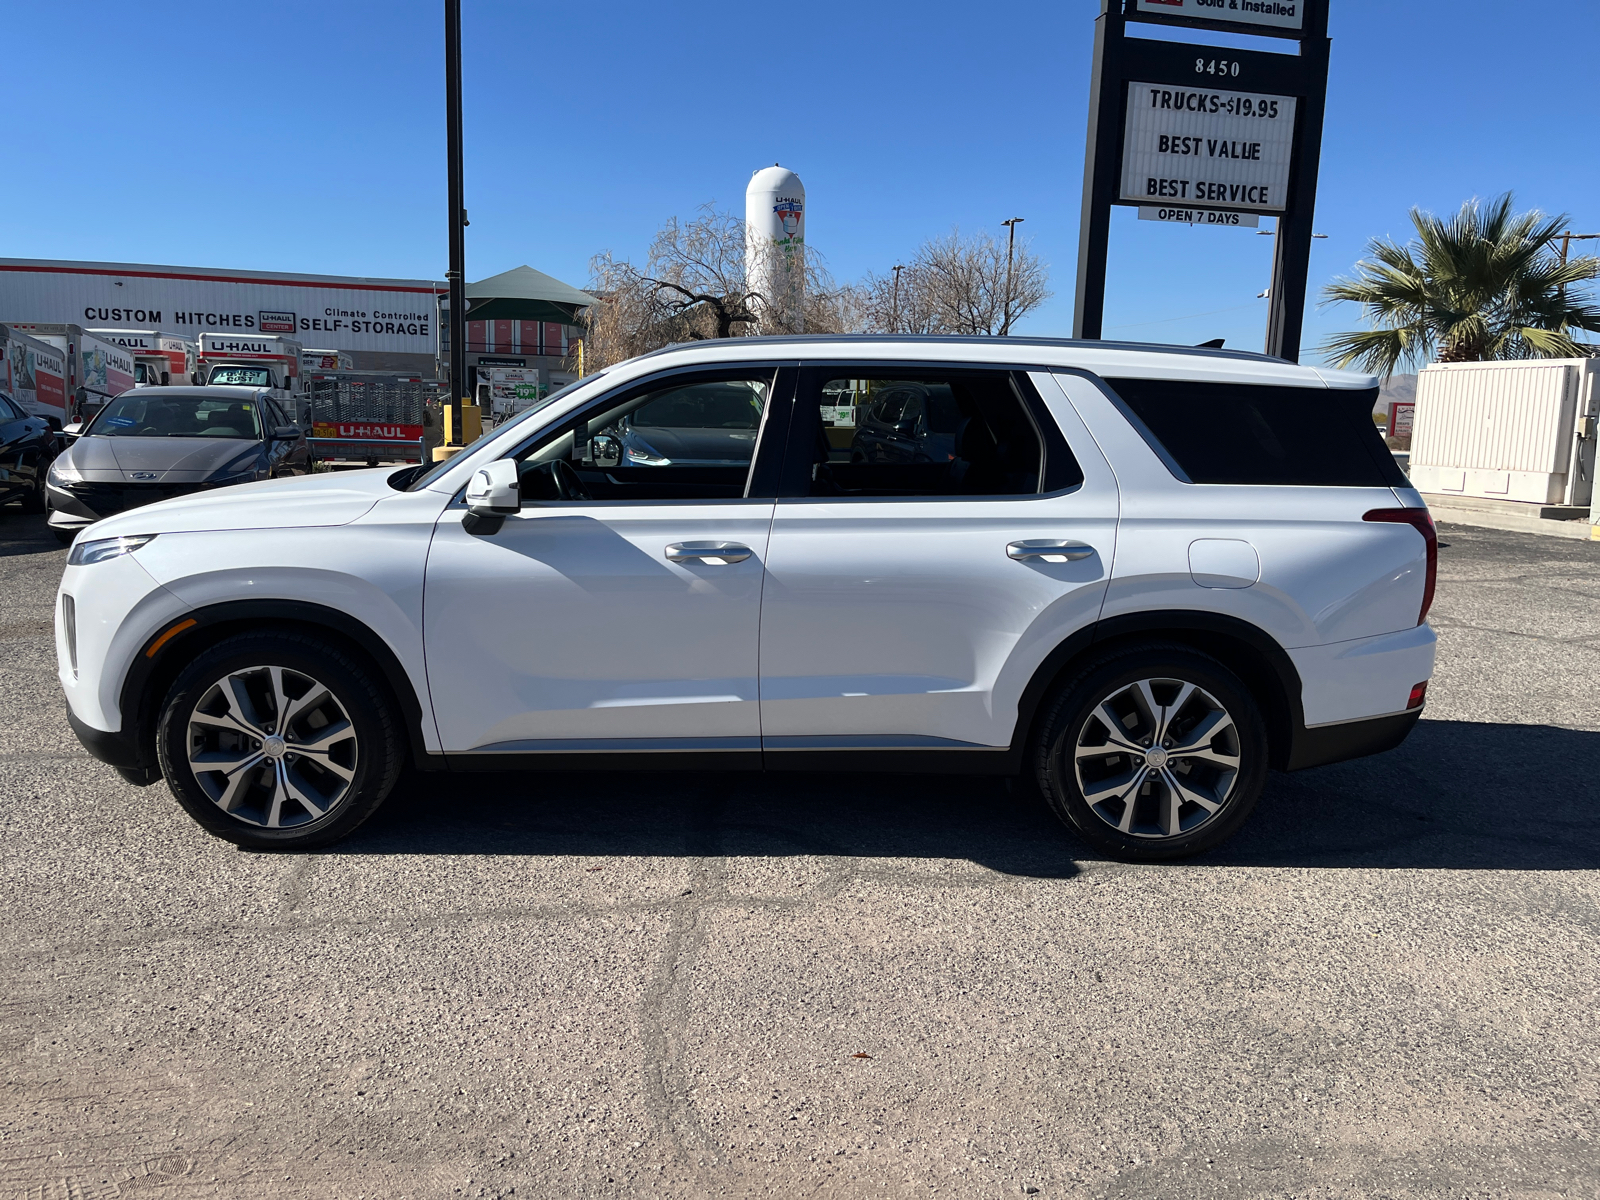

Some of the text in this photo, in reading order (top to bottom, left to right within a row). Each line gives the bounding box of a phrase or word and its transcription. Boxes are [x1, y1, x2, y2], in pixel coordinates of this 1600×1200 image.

[1229, 0, 1238, 10] &
[1241, 0, 1295, 16] Installed
[1195, 58, 1239, 77] 8450
[1151, 89, 1278, 118] TRUCKS-$19.95
[1159, 135, 1260, 160] BEST VALUE
[1147, 178, 1268, 203] BEST SERVICE
[1158, 209, 1239, 224] OPEN 7 DAYS
[85, 308, 255, 327] CUSTOM HITCHES
[325, 308, 428, 321] Climate Controlled
[300, 318, 428, 335] SELF-STORAGE
[212, 342, 271, 352] U-HAUL
[36, 353, 61, 373] U-HAUL
[106, 352, 132, 374] U-HAUL
[340, 425, 405, 437] U-HAUL
